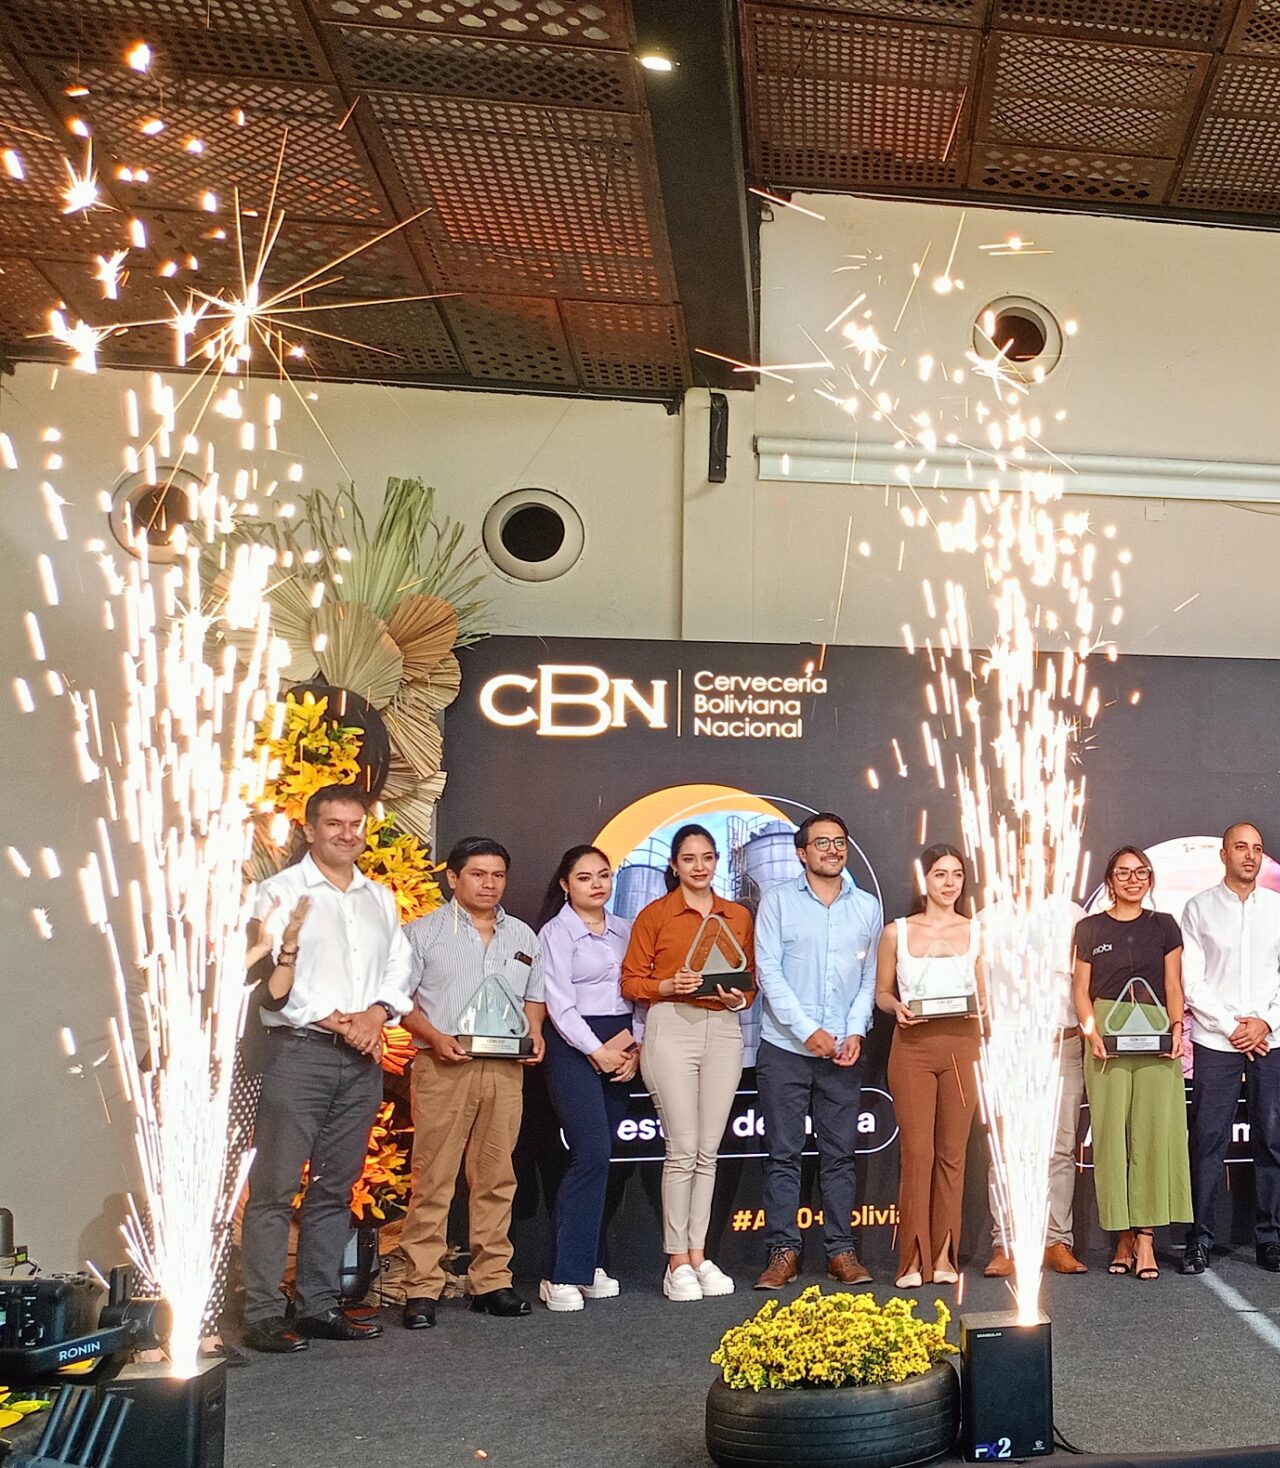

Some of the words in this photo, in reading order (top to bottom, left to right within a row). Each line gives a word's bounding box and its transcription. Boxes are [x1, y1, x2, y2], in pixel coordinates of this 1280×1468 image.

[479, 664, 668, 736] CBN
[694, 693, 801, 715] Boliviana
[694, 717, 803, 738] Nacional
[58, 1340, 101, 1362] RONIN
